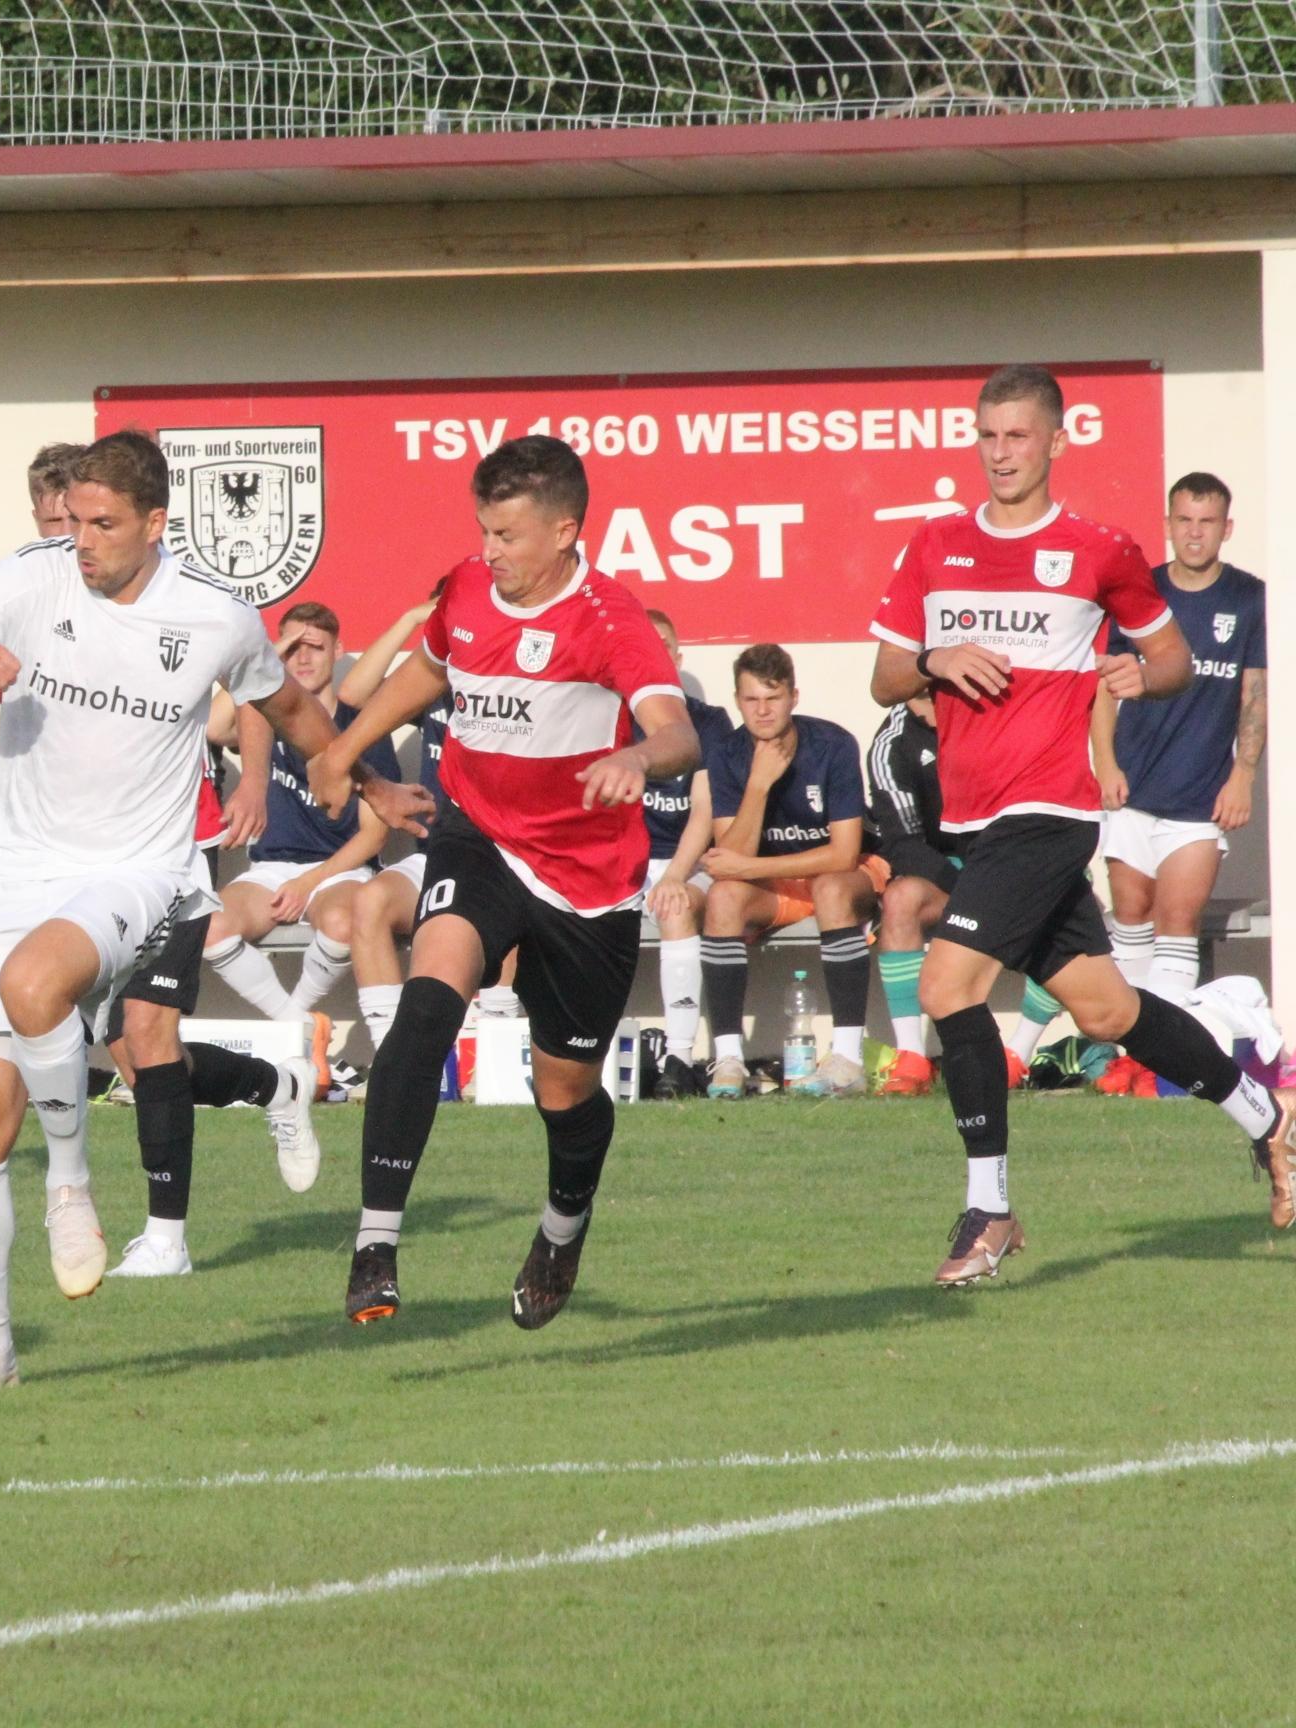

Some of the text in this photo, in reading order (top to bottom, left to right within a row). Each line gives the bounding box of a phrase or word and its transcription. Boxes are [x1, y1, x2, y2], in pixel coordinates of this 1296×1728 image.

[395, 417, 508, 460] TSV
[676, 404, 1103, 454] WEISSENBG
[165, 438, 317, 458] Turn- und Sportverein
[169, 465, 317, 487] 18 60
[277, 513, 317, 587] BAYERN
[574, 503, 804, 582] AST
[944, 555, 975, 568] JAKO
[940, 608, 1051, 636] DOTLUX
[29, 662, 183, 723] immohaus
[455, 690, 533, 723] OTLUX
[643, 791, 690, 812] ohau
[767, 824, 831, 841] mohau
[420, 878, 456, 920] 10
[946, 914, 979, 931] JAKO
[150, 975, 178, 989] JAKO
[567, 1036, 599, 1048] JAKO
